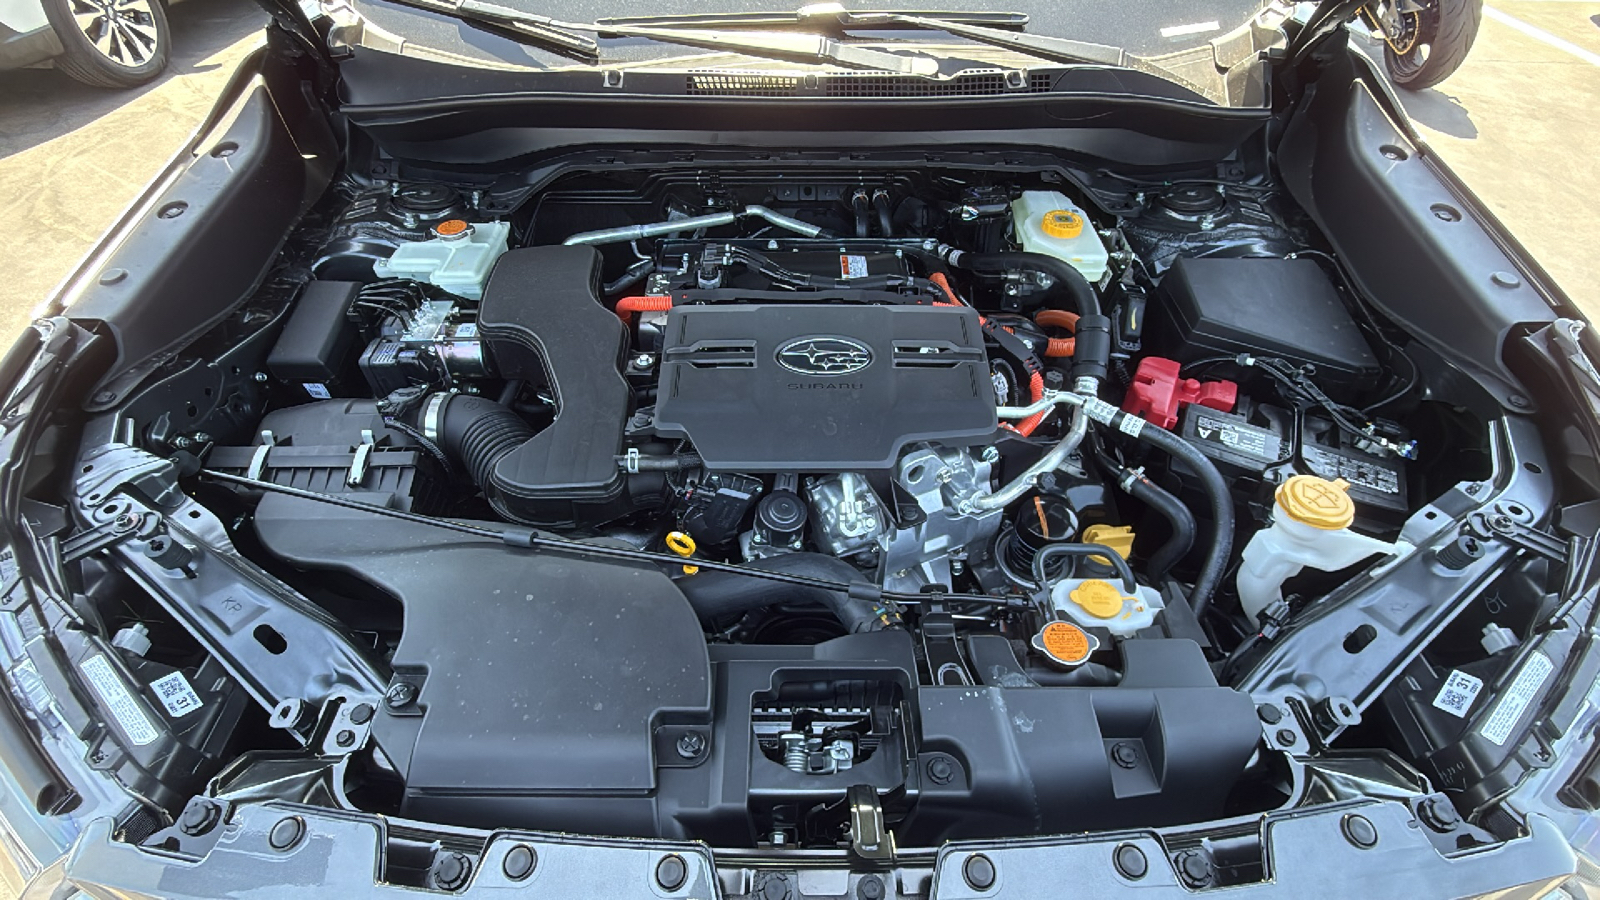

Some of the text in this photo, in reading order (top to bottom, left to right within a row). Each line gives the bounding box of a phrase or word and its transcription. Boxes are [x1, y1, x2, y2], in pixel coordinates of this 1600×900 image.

[787, 382, 863, 390] SUBARU
[1456, 677, 1472, 690] 31
[176, 696, 191, 709] 31
